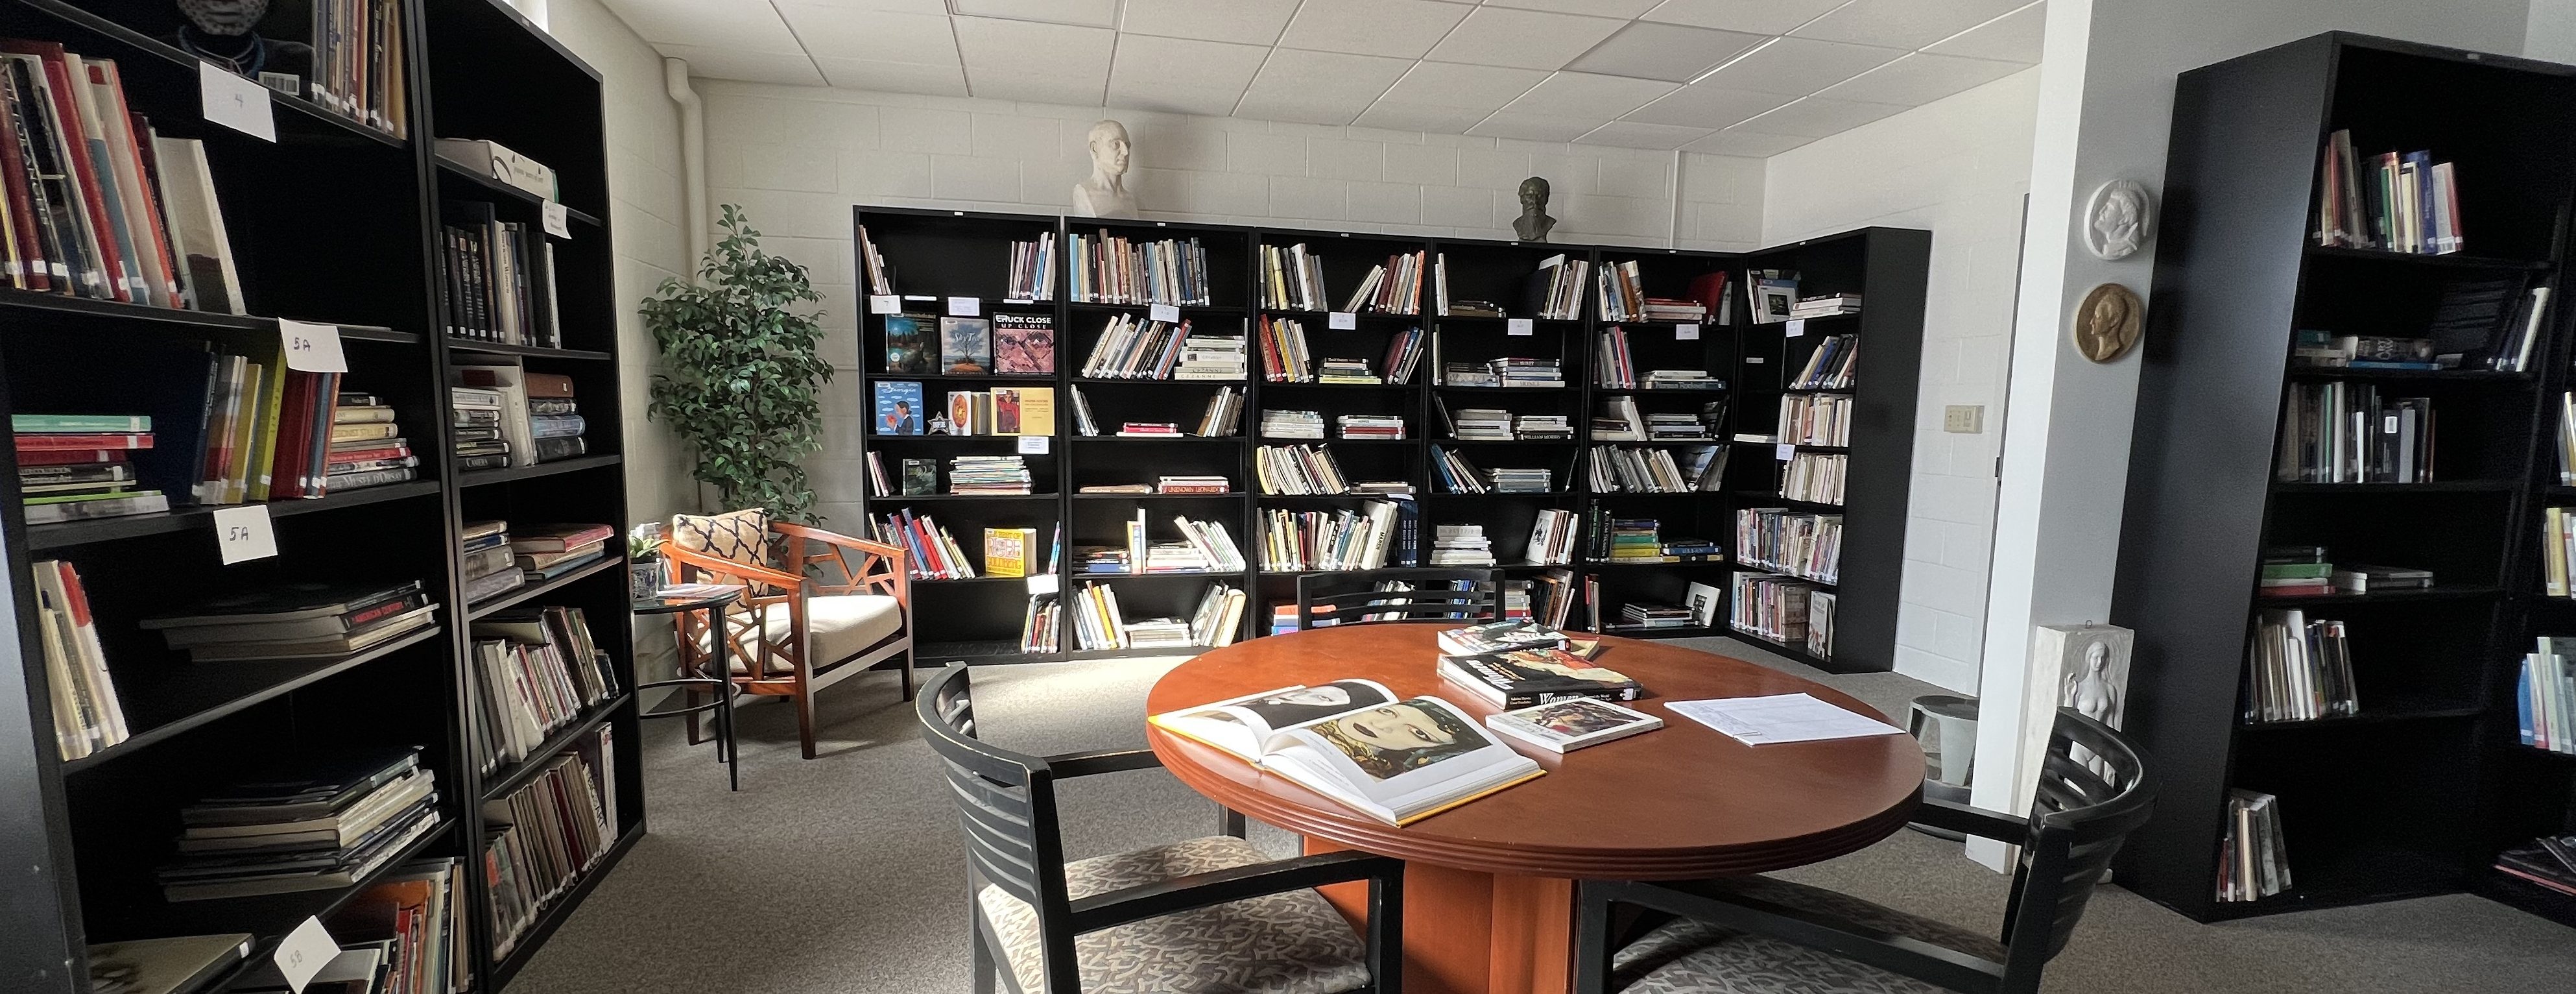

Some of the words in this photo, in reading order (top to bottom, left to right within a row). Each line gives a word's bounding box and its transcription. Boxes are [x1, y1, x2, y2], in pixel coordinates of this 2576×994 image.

[235, 93, 243, 108] 4
[293, 337, 311, 352] 5A
[229, 526, 248, 541] 5A
